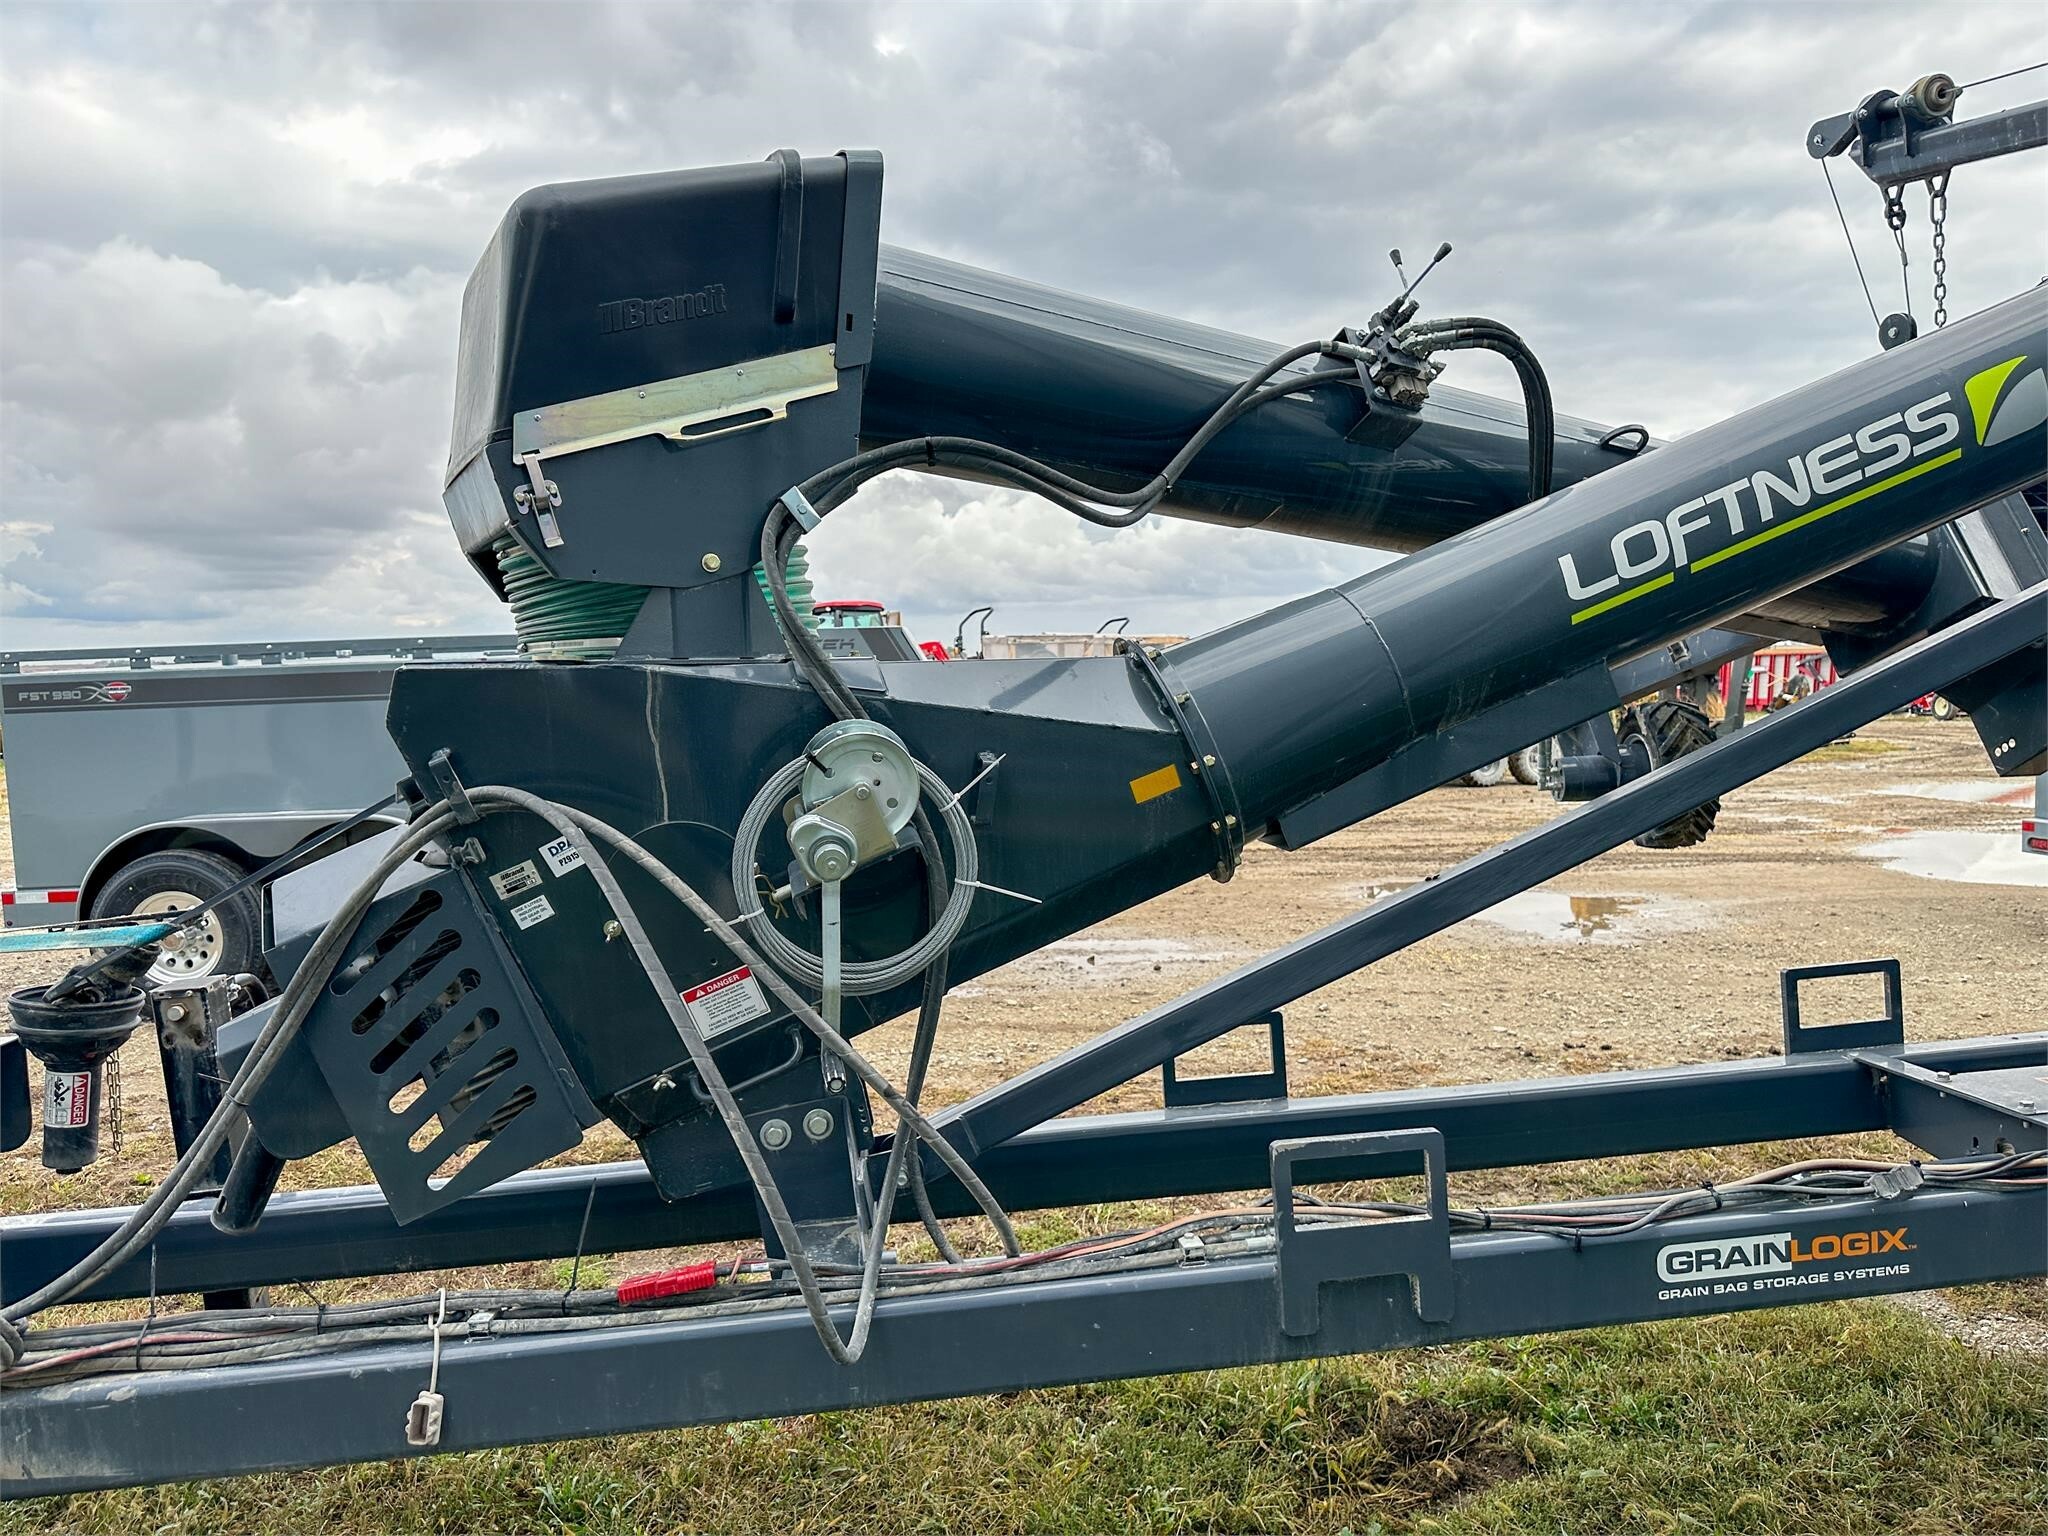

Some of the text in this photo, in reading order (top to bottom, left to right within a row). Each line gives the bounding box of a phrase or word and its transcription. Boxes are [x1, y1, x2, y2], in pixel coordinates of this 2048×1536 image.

[622, 283, 728, 329] Brandt
[1557, 391, 1960, 601] LOFTNESS
[18, 690, 82, 702] FST 990
[706, 974, 740, 993] DANGER
[73, 1087, 86, 1124] DANGER
[1658, 1263, 1911, 1301] GRAIN BAG STORAGE SYSTEMS
